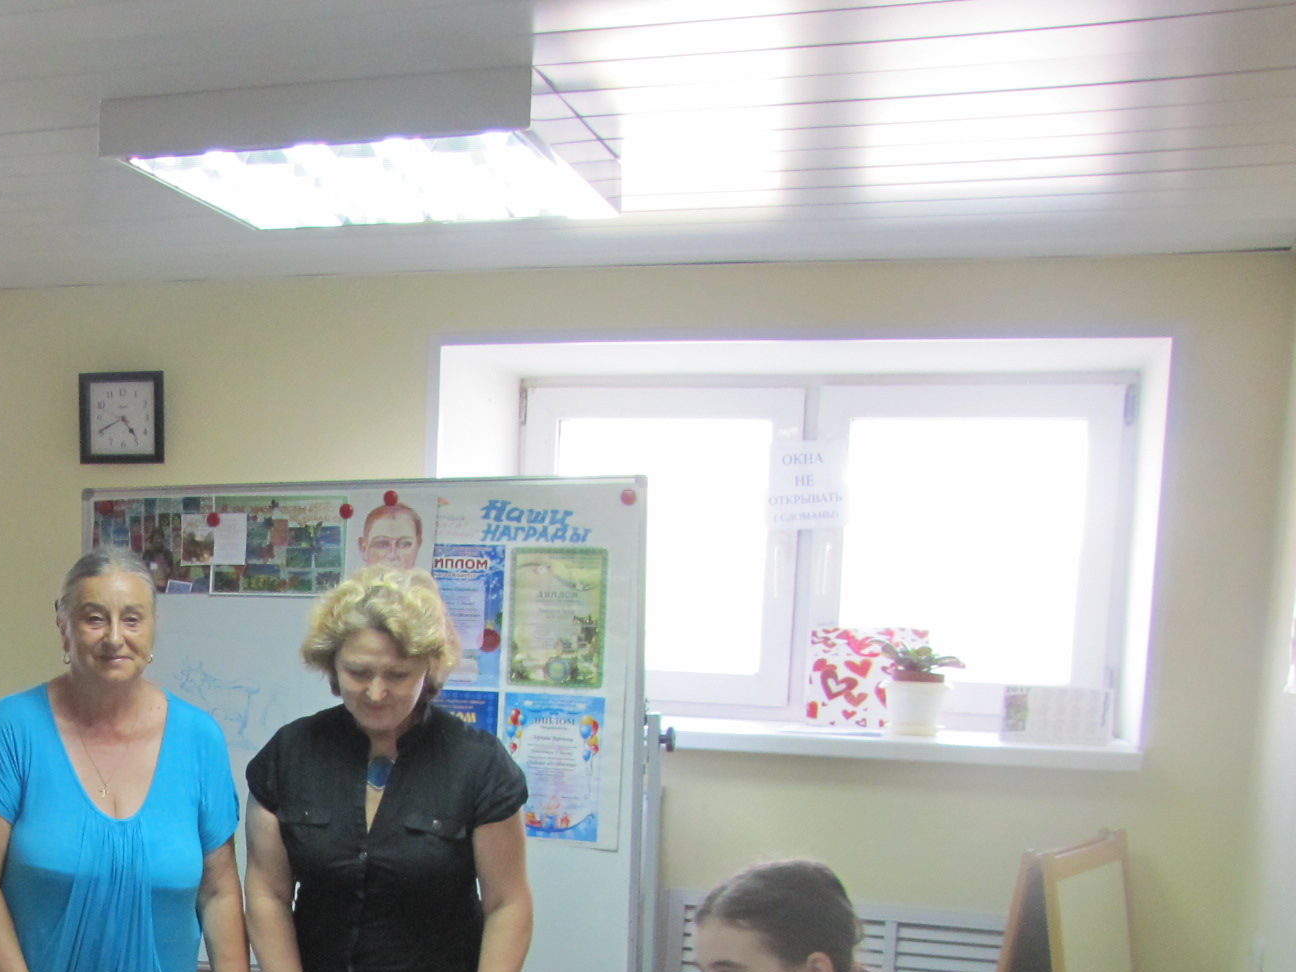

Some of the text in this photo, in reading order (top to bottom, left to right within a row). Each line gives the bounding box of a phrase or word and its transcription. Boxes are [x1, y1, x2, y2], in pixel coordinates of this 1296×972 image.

[782, 453, 823, 465] ОКНА
[794, 474, 816, 487] НЕ
[768, 492, 842, 505] ОТКРЫВАТЬ
[434, 558, 488, 570] ИПЛОМ
